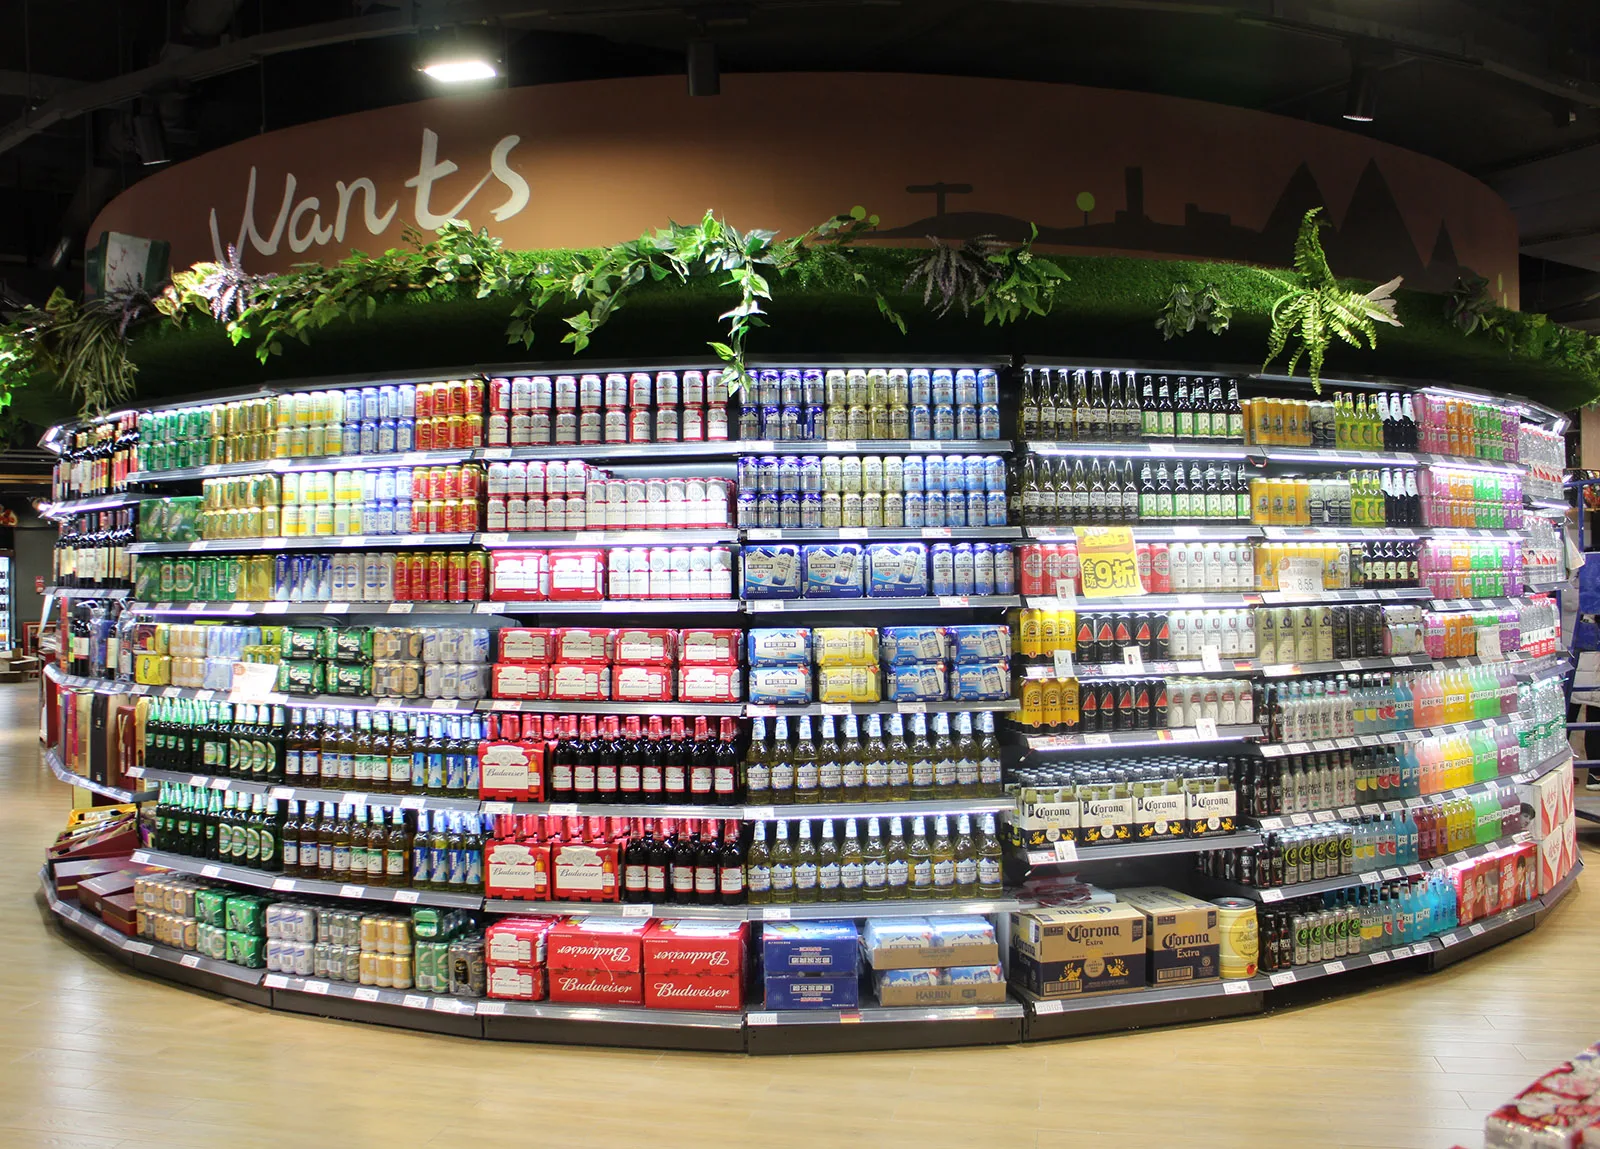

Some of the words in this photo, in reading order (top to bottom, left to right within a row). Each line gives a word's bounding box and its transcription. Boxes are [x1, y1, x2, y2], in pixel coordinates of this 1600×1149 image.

[209, 128, 531, 266] Wants
[486, 768, 524, 777] Budweiser
[1144, 800, 1177, 812] Corona
[1198, 796, 1229, 808] Corona
[1035, 807, 1070, 819] Corona
[1090, 804, 1124, 816] Corona
[492, 868, 531, 876] Budweiser
[559, 869, 599, 877] Budweiser
[1067, 924, 1120, 943] Corona
[1162, 932, 1210, 950] Corona
[557, 944, 632, 962] Budweiser
[653, 950, 730, 966] Budweiser
[1176, 949, 1200, 959] Extra
[558, 977, 632, 993] Budweiser
[653, 982, 730, 998] Budweiser
[915, 990, 951, 1000] HARBIN
